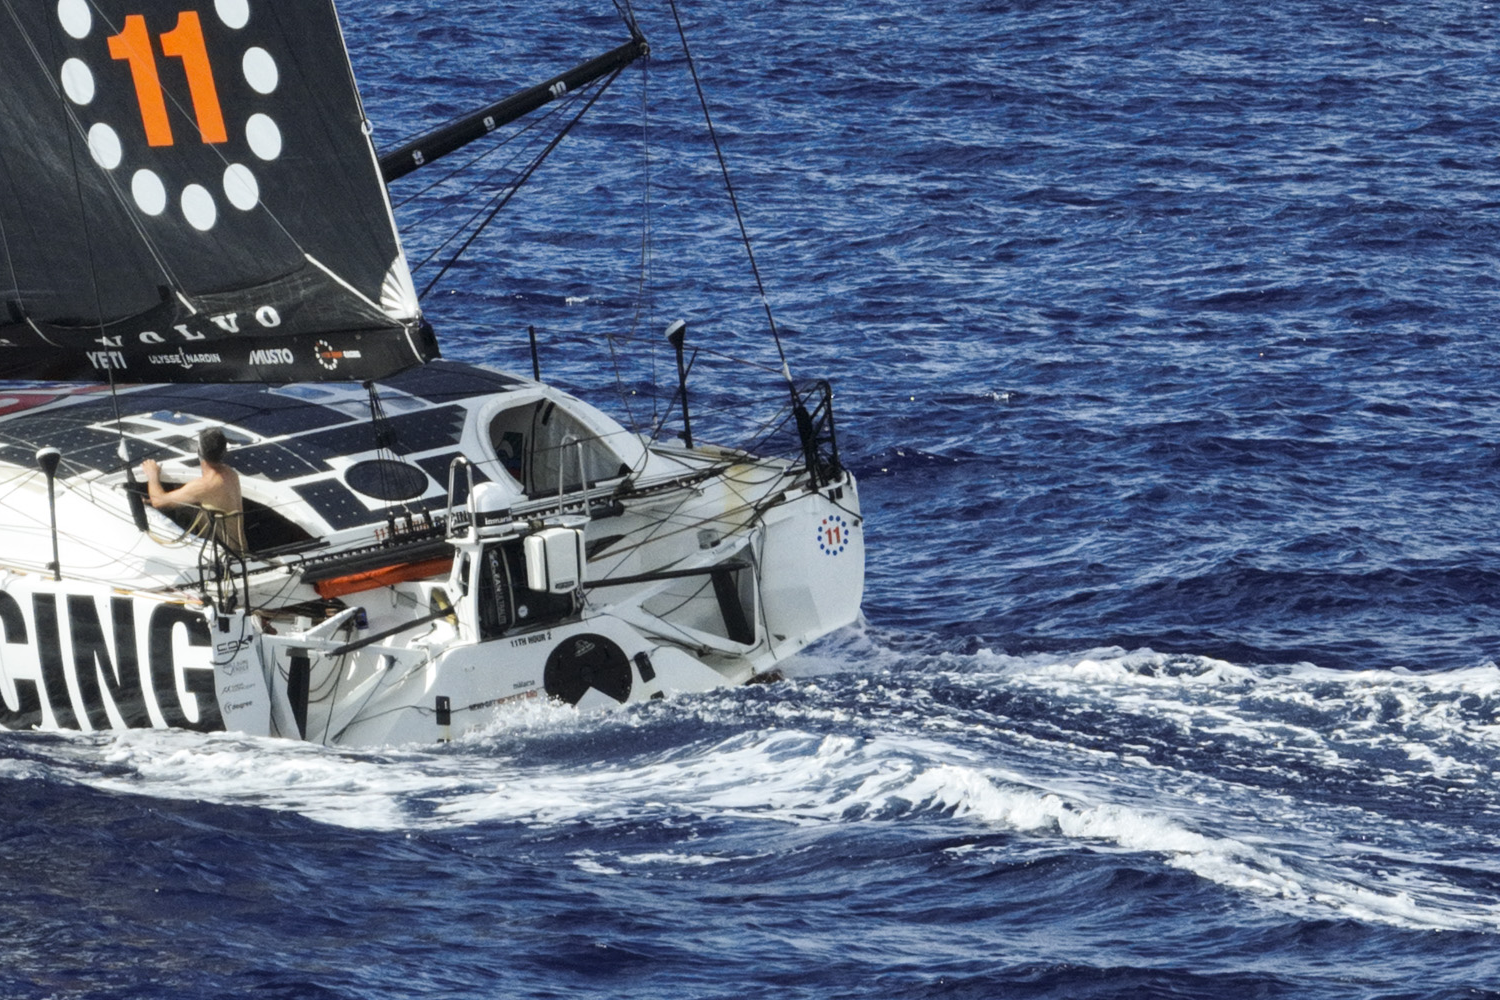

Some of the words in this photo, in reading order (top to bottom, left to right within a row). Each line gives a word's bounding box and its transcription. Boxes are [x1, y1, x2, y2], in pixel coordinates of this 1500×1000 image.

[107, 11, 228, 147] 11
[94, 305, 281, 348] VOLVO
[86, 351, 128, 370] YETI
[148, 354, 181, 365] ULYSSE
[185, 353, 222, 364] NARDIN
[249, 348, 294, 366] MUSTO
[825, 526, 841, 545] 11
[510, 637, 527, 647] 11TH
[528, 633, 546, 644] HOUR
